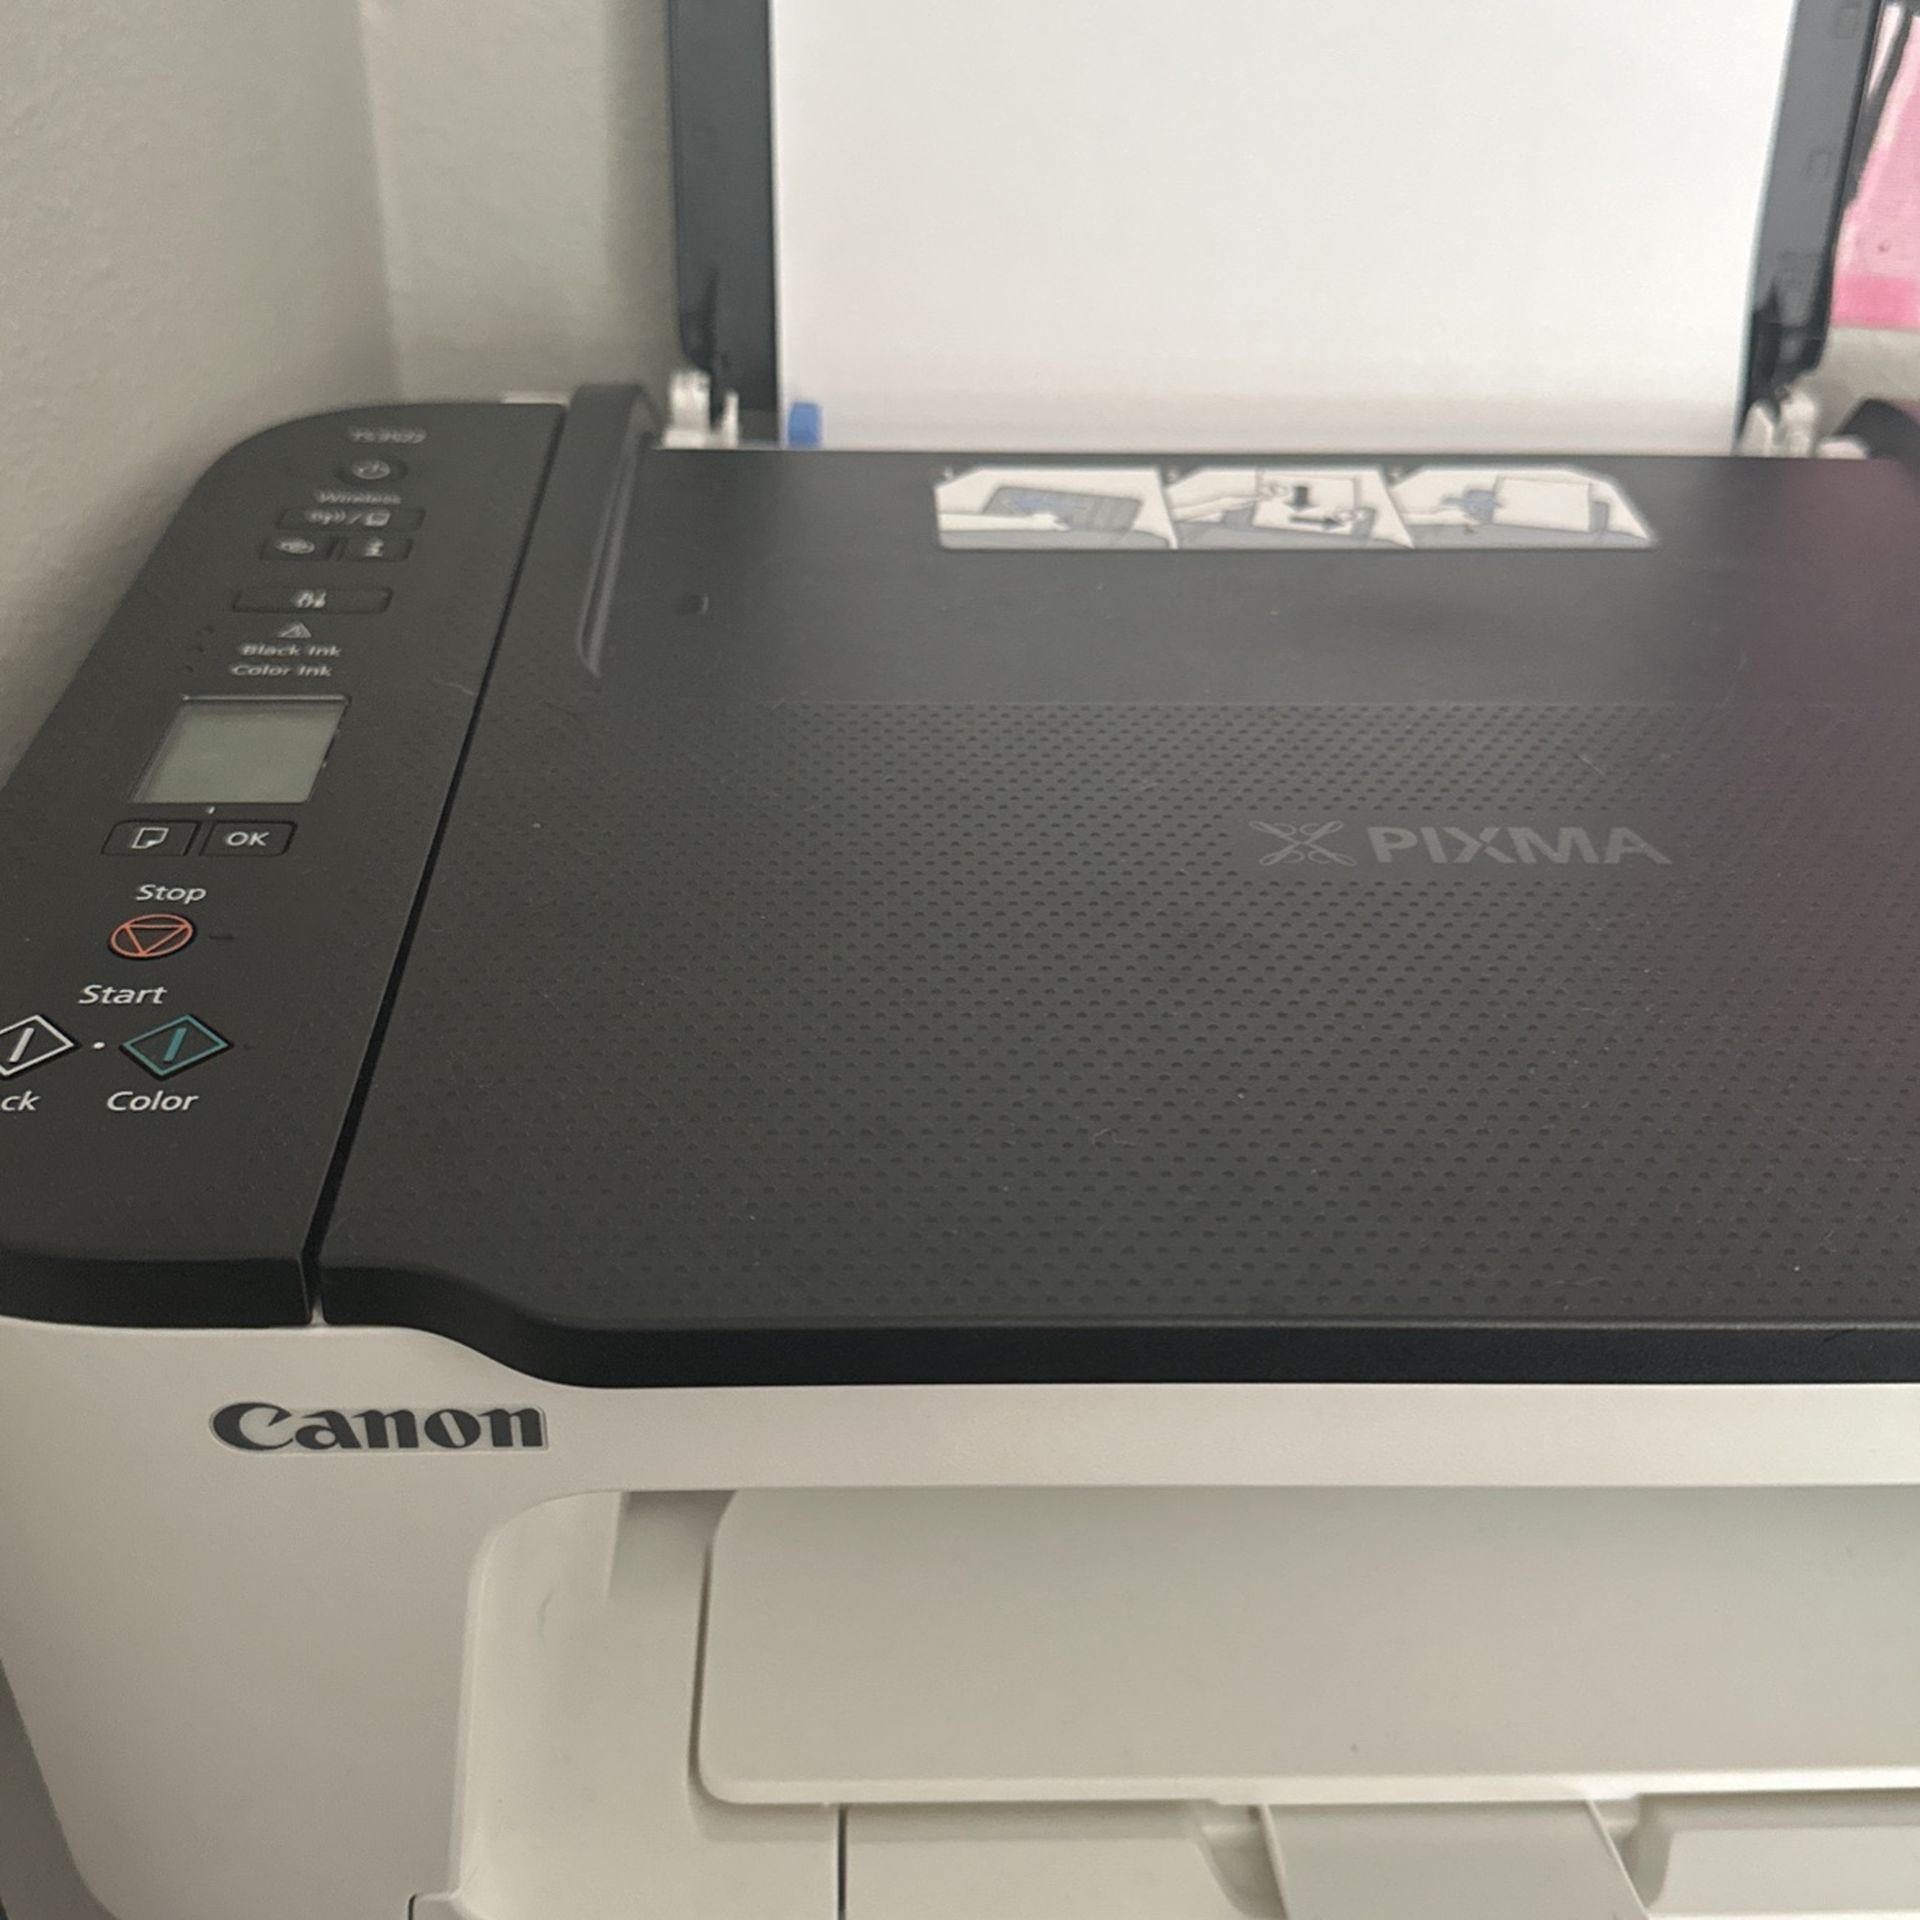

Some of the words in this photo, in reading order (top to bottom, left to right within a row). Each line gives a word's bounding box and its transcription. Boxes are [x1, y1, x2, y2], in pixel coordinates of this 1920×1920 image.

[241, 644, 301, 656] Black
[308, 644, 341, 656] Ink
[231, 664, 292, 676] Color
[298, 664, 332, 677] Ink
[226, 831, 270, 847] OK
[1366, 826, 1671, 864] PIXMA
[136, 884, 207, 904] Stop
[79, 984, 167, 1005] Start
[107, 1090, 199, 1112] Color
[212, 1401, 543, 1451] Canon
